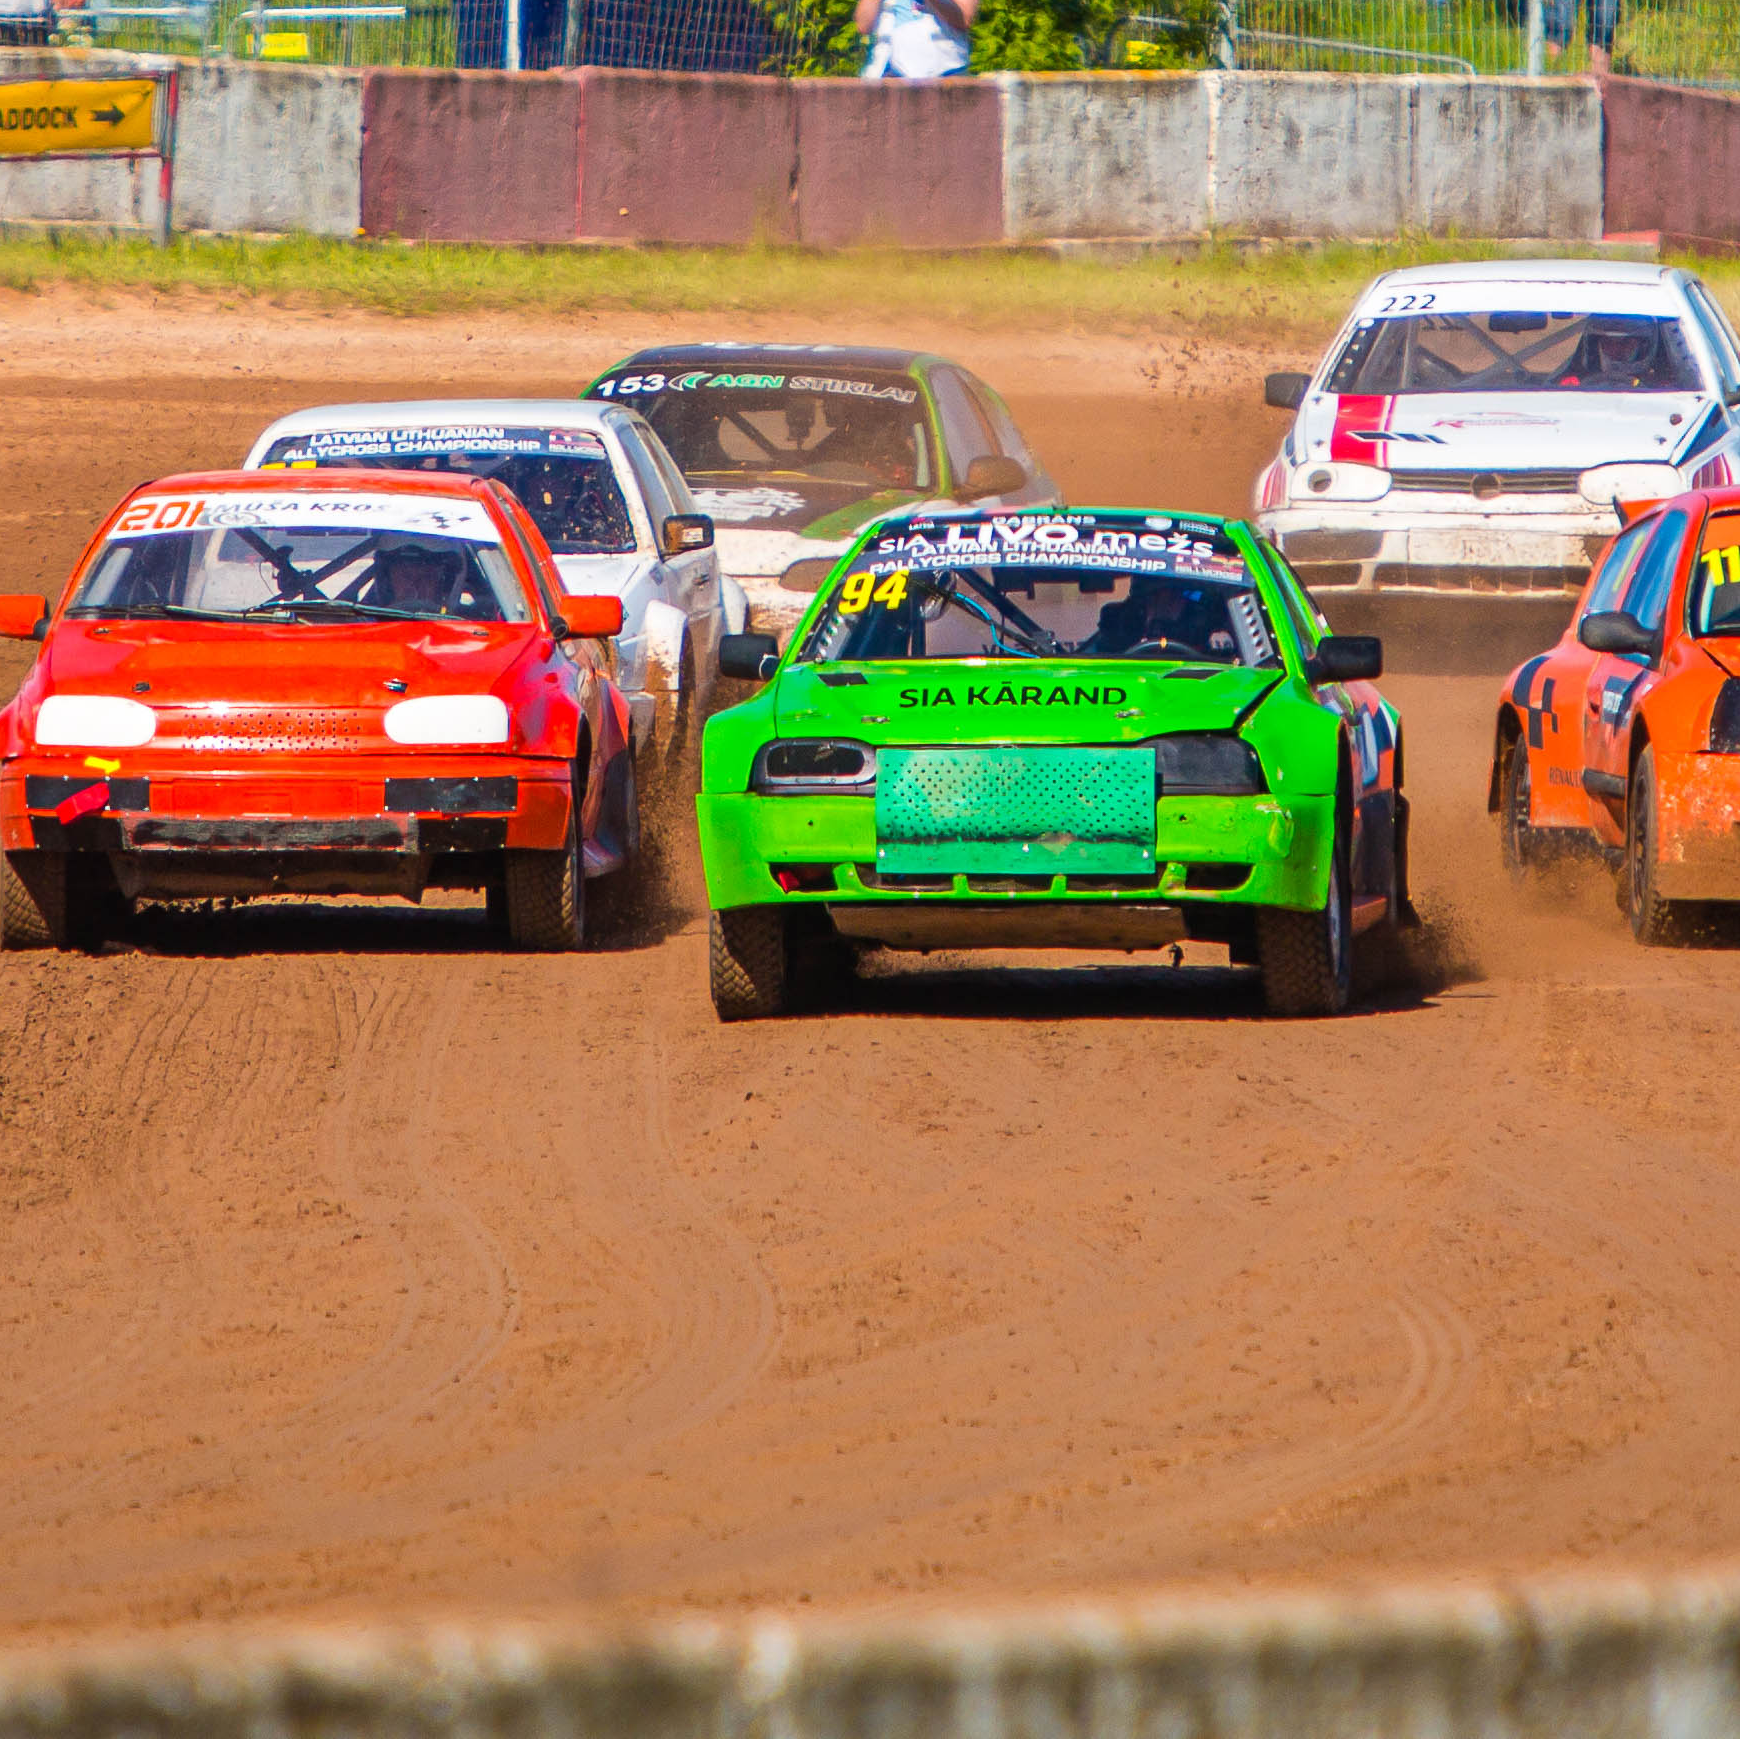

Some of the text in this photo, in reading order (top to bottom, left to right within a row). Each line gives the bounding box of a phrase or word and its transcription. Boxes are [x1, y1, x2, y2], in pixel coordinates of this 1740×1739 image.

[1380, 294, 1436, 313] 222
[597, 373, 666, 398] 153
[309, 426, 505, 448] LATVIAN LITHUANIAN
[394, 439, 541, 455] CHAMPIONSHIP
[117, 500, 205, 532] 201
[878, 522, 1214, 558] SIA LIVO mežs
[911, 538, 998, 558] LATVIAN
[869, 551, 1167, 575] RALLYCROSS CHAMPIONSHIP
[838, 569, 910, 615] 94
[899, 680, 1128, 709] SIA KĀRAND
